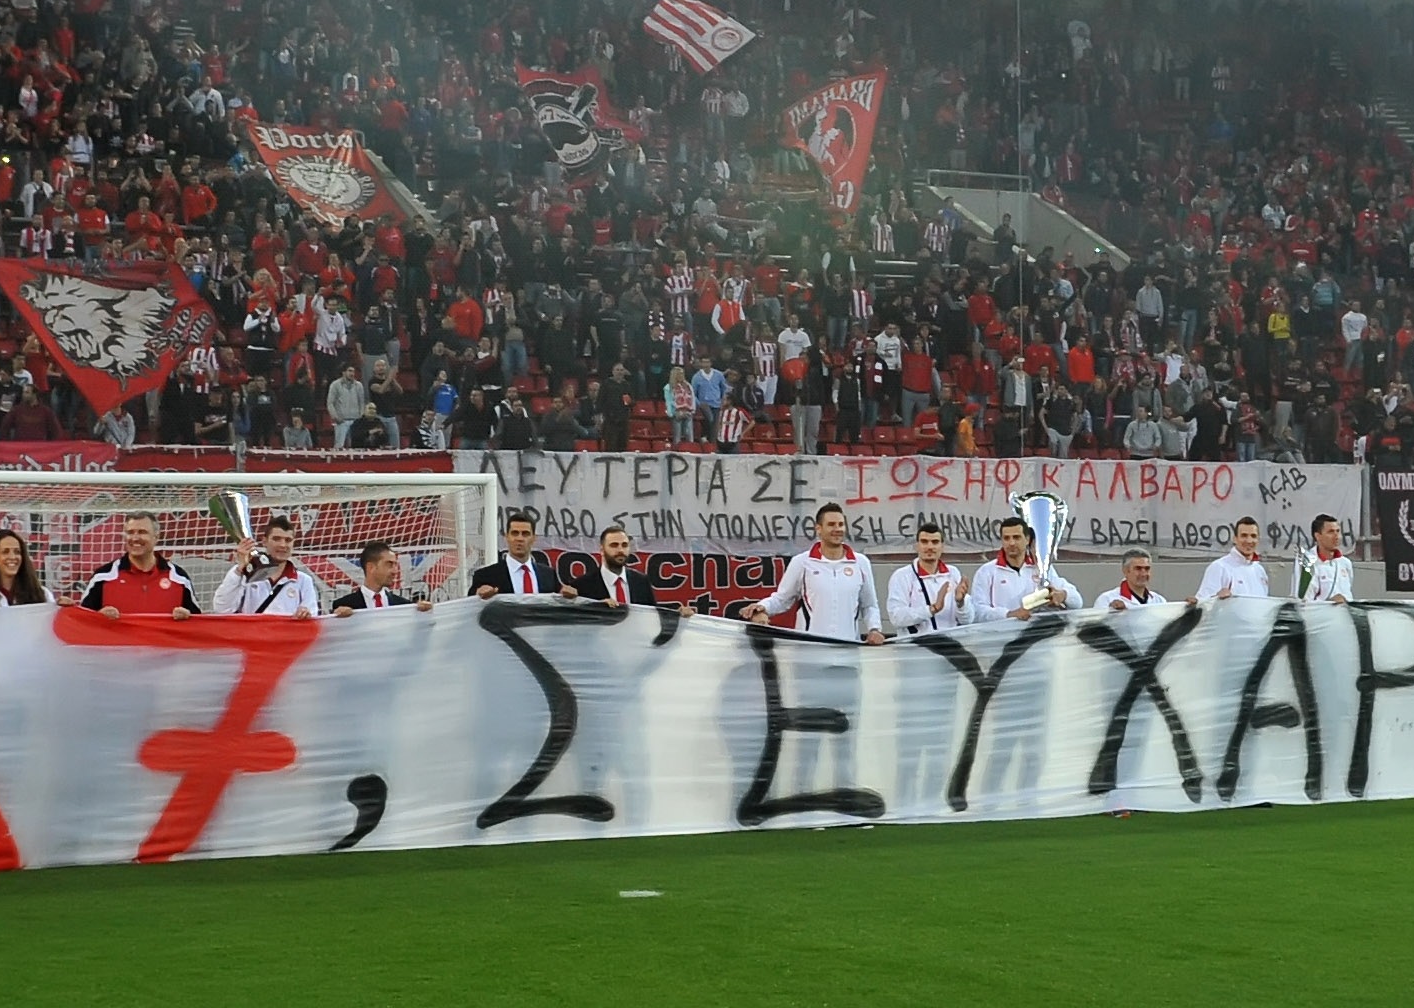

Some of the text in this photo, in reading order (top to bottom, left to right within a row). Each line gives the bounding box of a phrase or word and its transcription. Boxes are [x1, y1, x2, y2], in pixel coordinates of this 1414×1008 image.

[479, 450, 727, 505] ΛΕΥΤΕΡΙΑ
[751, 459, 819, 504] ΣΕ
[842, 457, 1021, 505] ΙΩΣΗΦ
[1075, 460, 1234, 504] ΑΛΒΑΡΟ
[1090, 517, 1158, 546] ΒΑΖΕΙ
